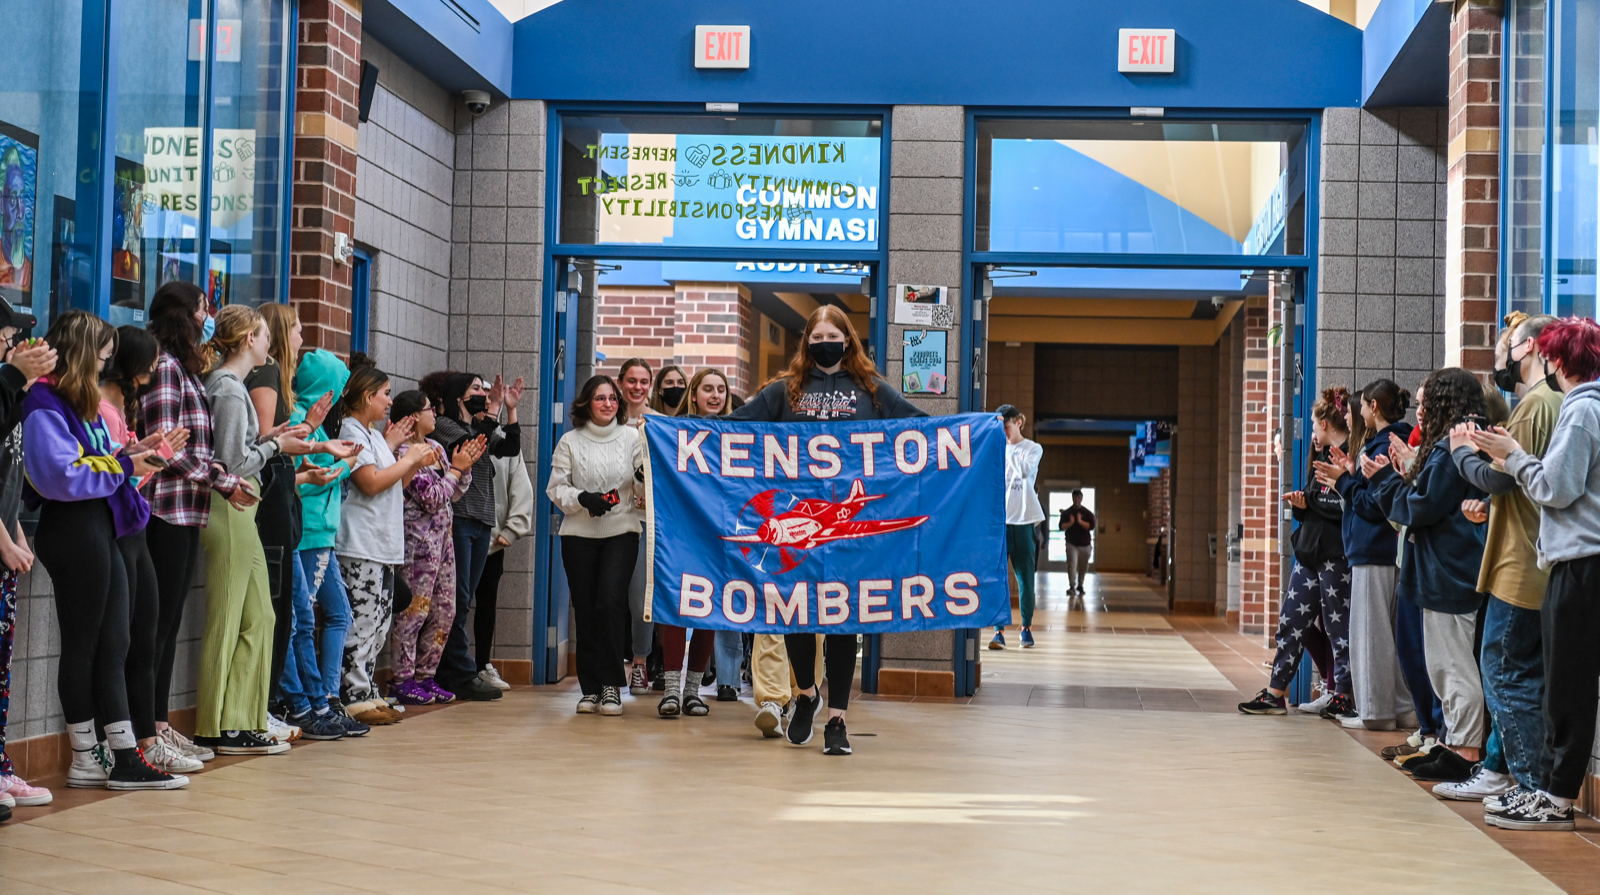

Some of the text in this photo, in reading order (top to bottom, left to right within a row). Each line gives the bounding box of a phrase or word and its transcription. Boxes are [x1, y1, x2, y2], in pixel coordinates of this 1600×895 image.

[705, 31, 743, 61] EXIT
[1128, 35, 1168, 65] EXIT
[735, 216, 879, 242] GYMNASI
[677, 424, 972, 479] KENSTON
[679, 571, 980, 626] BOMBERS
